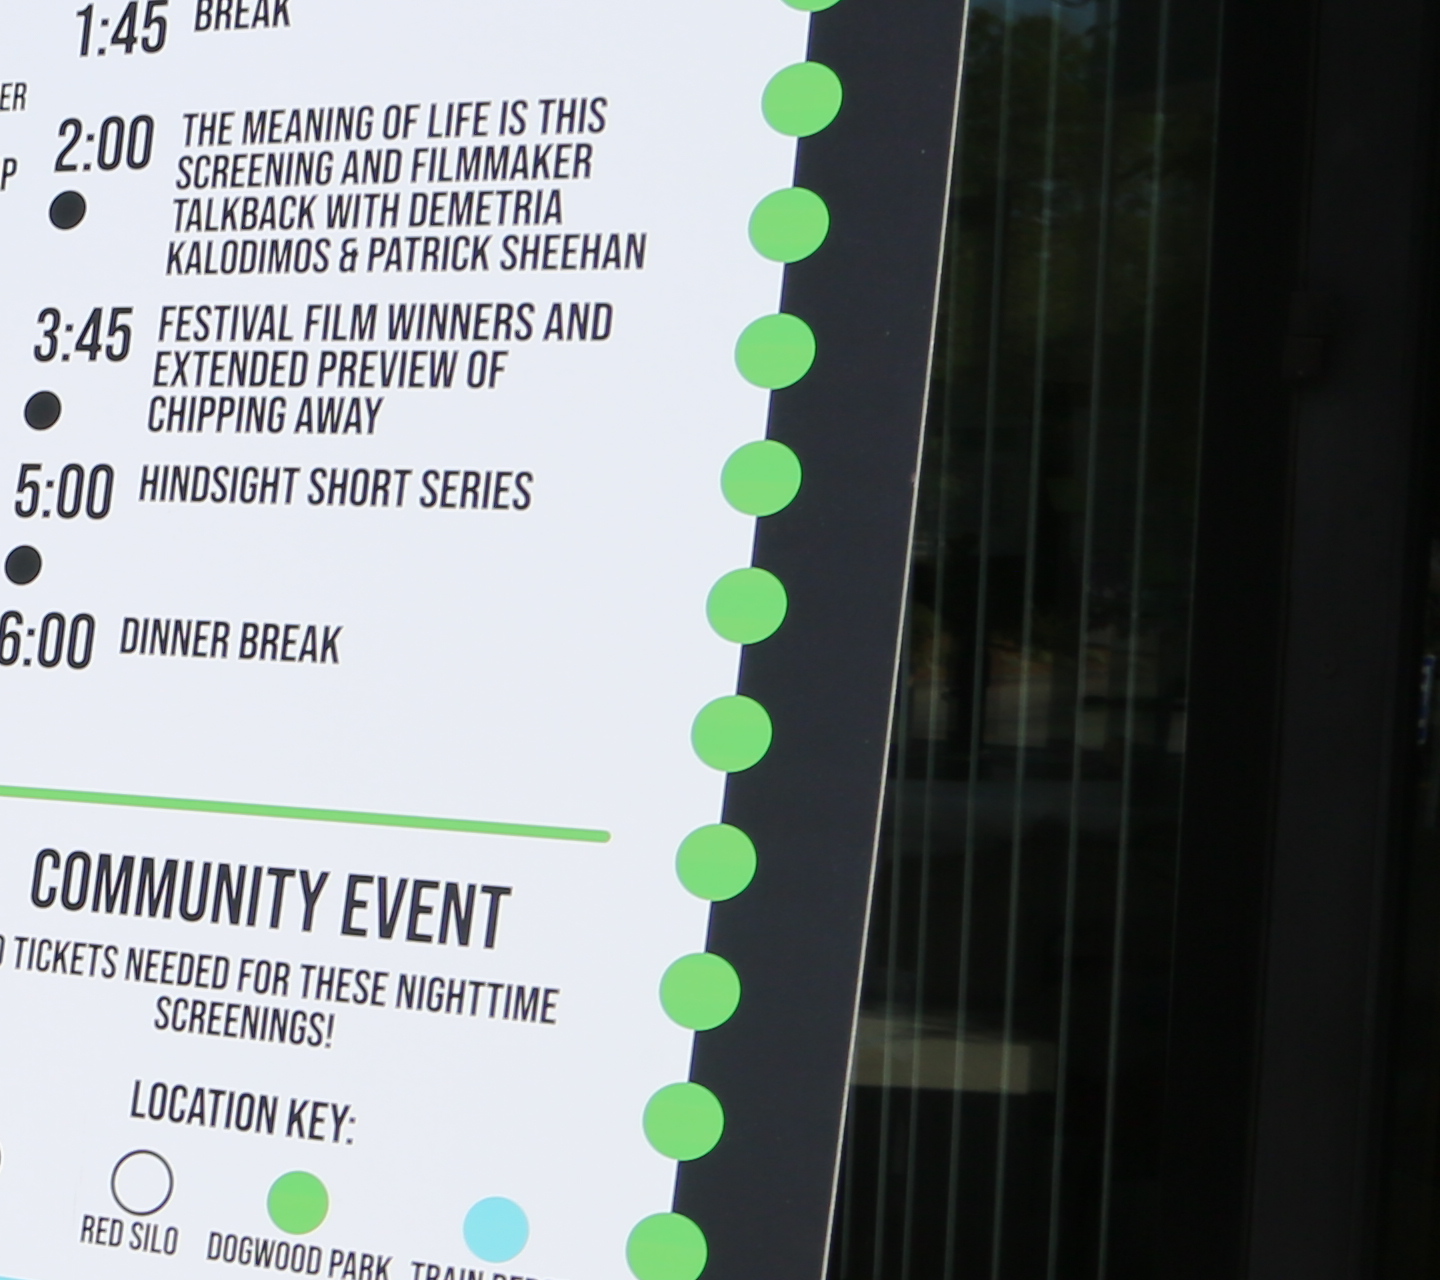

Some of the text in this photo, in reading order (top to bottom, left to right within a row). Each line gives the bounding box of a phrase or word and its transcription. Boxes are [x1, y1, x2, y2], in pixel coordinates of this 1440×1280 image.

[52, 112, 156, 173] 2:00
[182, 95, 608, 147] THE MEANING OF LIFE IS THIS
[174, 141, 594, 191] SCREENING AND FILMMAKER
[172, 187, 563, 233] TALKBACK WITH DEMETRIA
[164, 231, 647, 276] KALODIMOS & PATRICK SHEEHAN
[31, 304, 134, 364] 3:45
[157, 301, 614, 343] FESTIVAL FILM WINNERS AND
[151, 348, 510, 389] EXTENDED PREVIEW OF
[146, 394, 384, 435] CHIPPING AWAY
[12, 461, 115, 521] 5:00
[138, 464, 534, 511] HINDSIGHT SHORT SERIES
[118, 616, 343, 665] DINNER BREAK
[29, 846, 513, 950] COMMUNITY EVENT
[13, 934, 119, 980] TICKETS
[124, 945, 231, 991] NEEDED
[236, 957, 291, 997] FOR
[299, 962, 389, 1007] THESE
[394, 972, 560, 1025] NIGHTTIME
[153, 994, 335, 1048] SCREENINGS!
[129, 1079, 350, 1144] LOCATION KEY:
[79, 1213, 179, 1256] RED SILO
